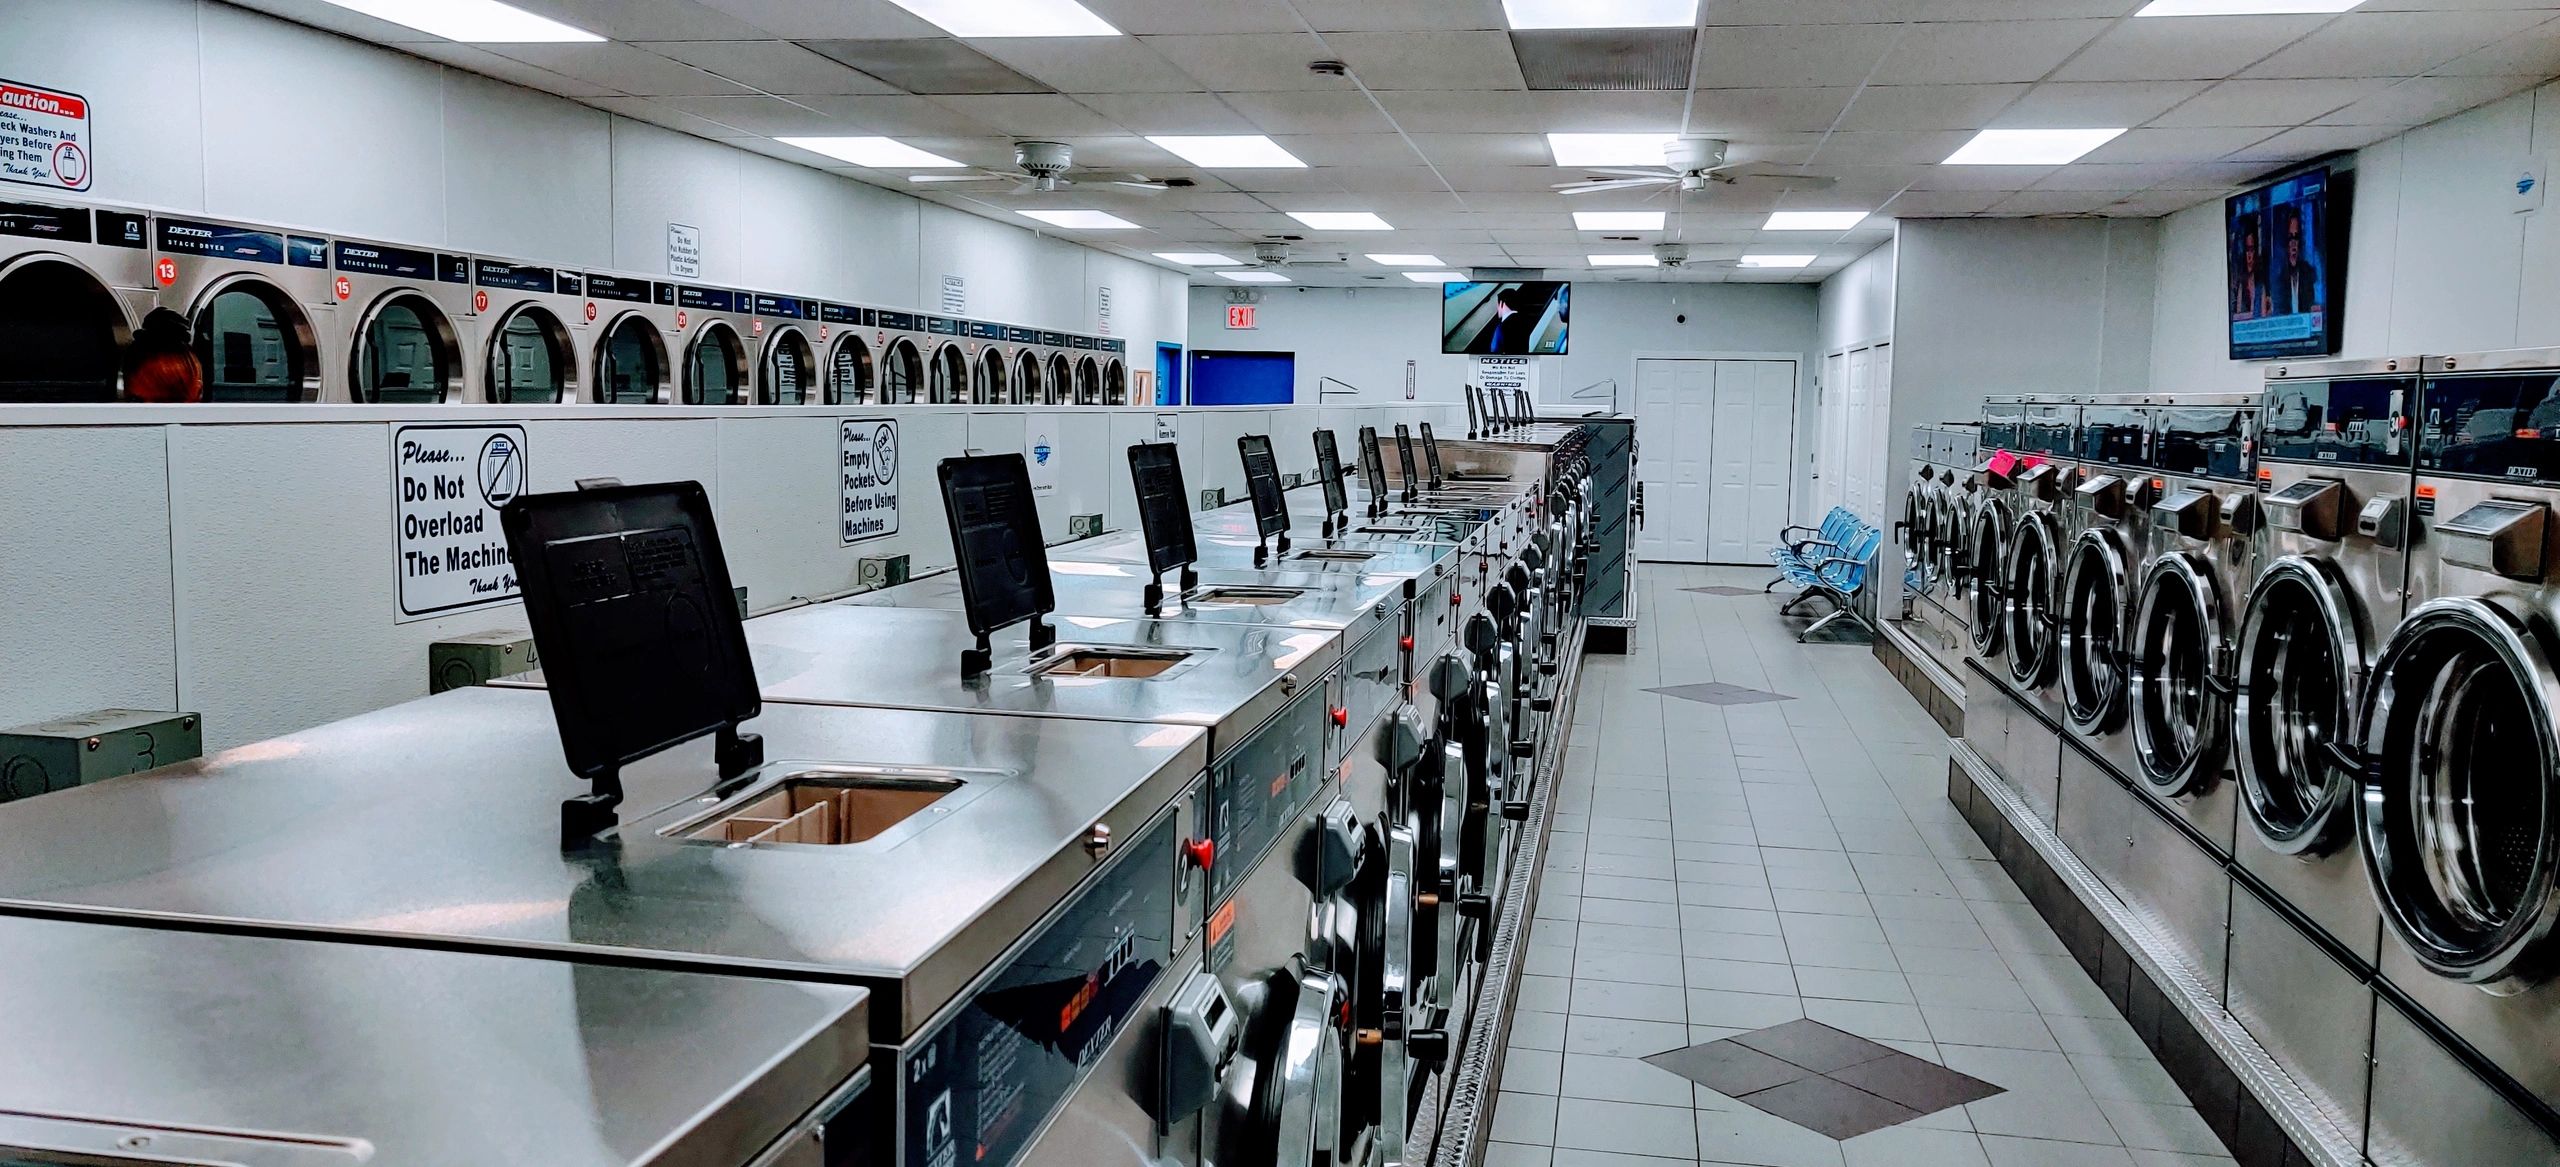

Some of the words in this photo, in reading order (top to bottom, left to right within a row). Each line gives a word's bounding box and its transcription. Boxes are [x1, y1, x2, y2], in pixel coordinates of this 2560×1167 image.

[19, 122, 57, 139] Washers
[60, 130, 76, 142] And
[22, 136, 52, 151] Before
[17, 149, 42, 163] Them
[3, 162, 28, 175] Thank
[31, 167, 51, 179] You!
[167, 226, 213, 238] DEXTER
[167, 239, 195, 248] STACK
[199, 243, 225, 251] DRYER
[343, 247, 379, 258] DEXTER
[159, 263, 175, 275] 13
[343, 259, 365, 267] STACK
[482, 265, 510, 275] DEXTER
[336, 281, 349, 294] 15
[476, 295, 486, 307] 17
[587, 306, 595, 317] 19
[1229, 307, 1256, 327] EXIT
[679, 315, 686, 325] 21
[843, 427, 871, 443] Please...
[402, 440, 464, 465] Please...
[843, 450, 870, 470] Empty
[2506, 466, 2538, 477] DEXTER
[403, 476, 427, 502] Do
[433, 474, 465, 500] Not
[844, 472, 875, 491] Pockets
[844, 495, 872, 514] Before
[874, 492, 896, 511] Using
[404, 508, 484, 540] Overload
[845, 517, 884, 537] Machines
[405, 550, 440, 577] The
[469, 576, 499, 595] Thank
[1180, 853, 1188, 893] 2
